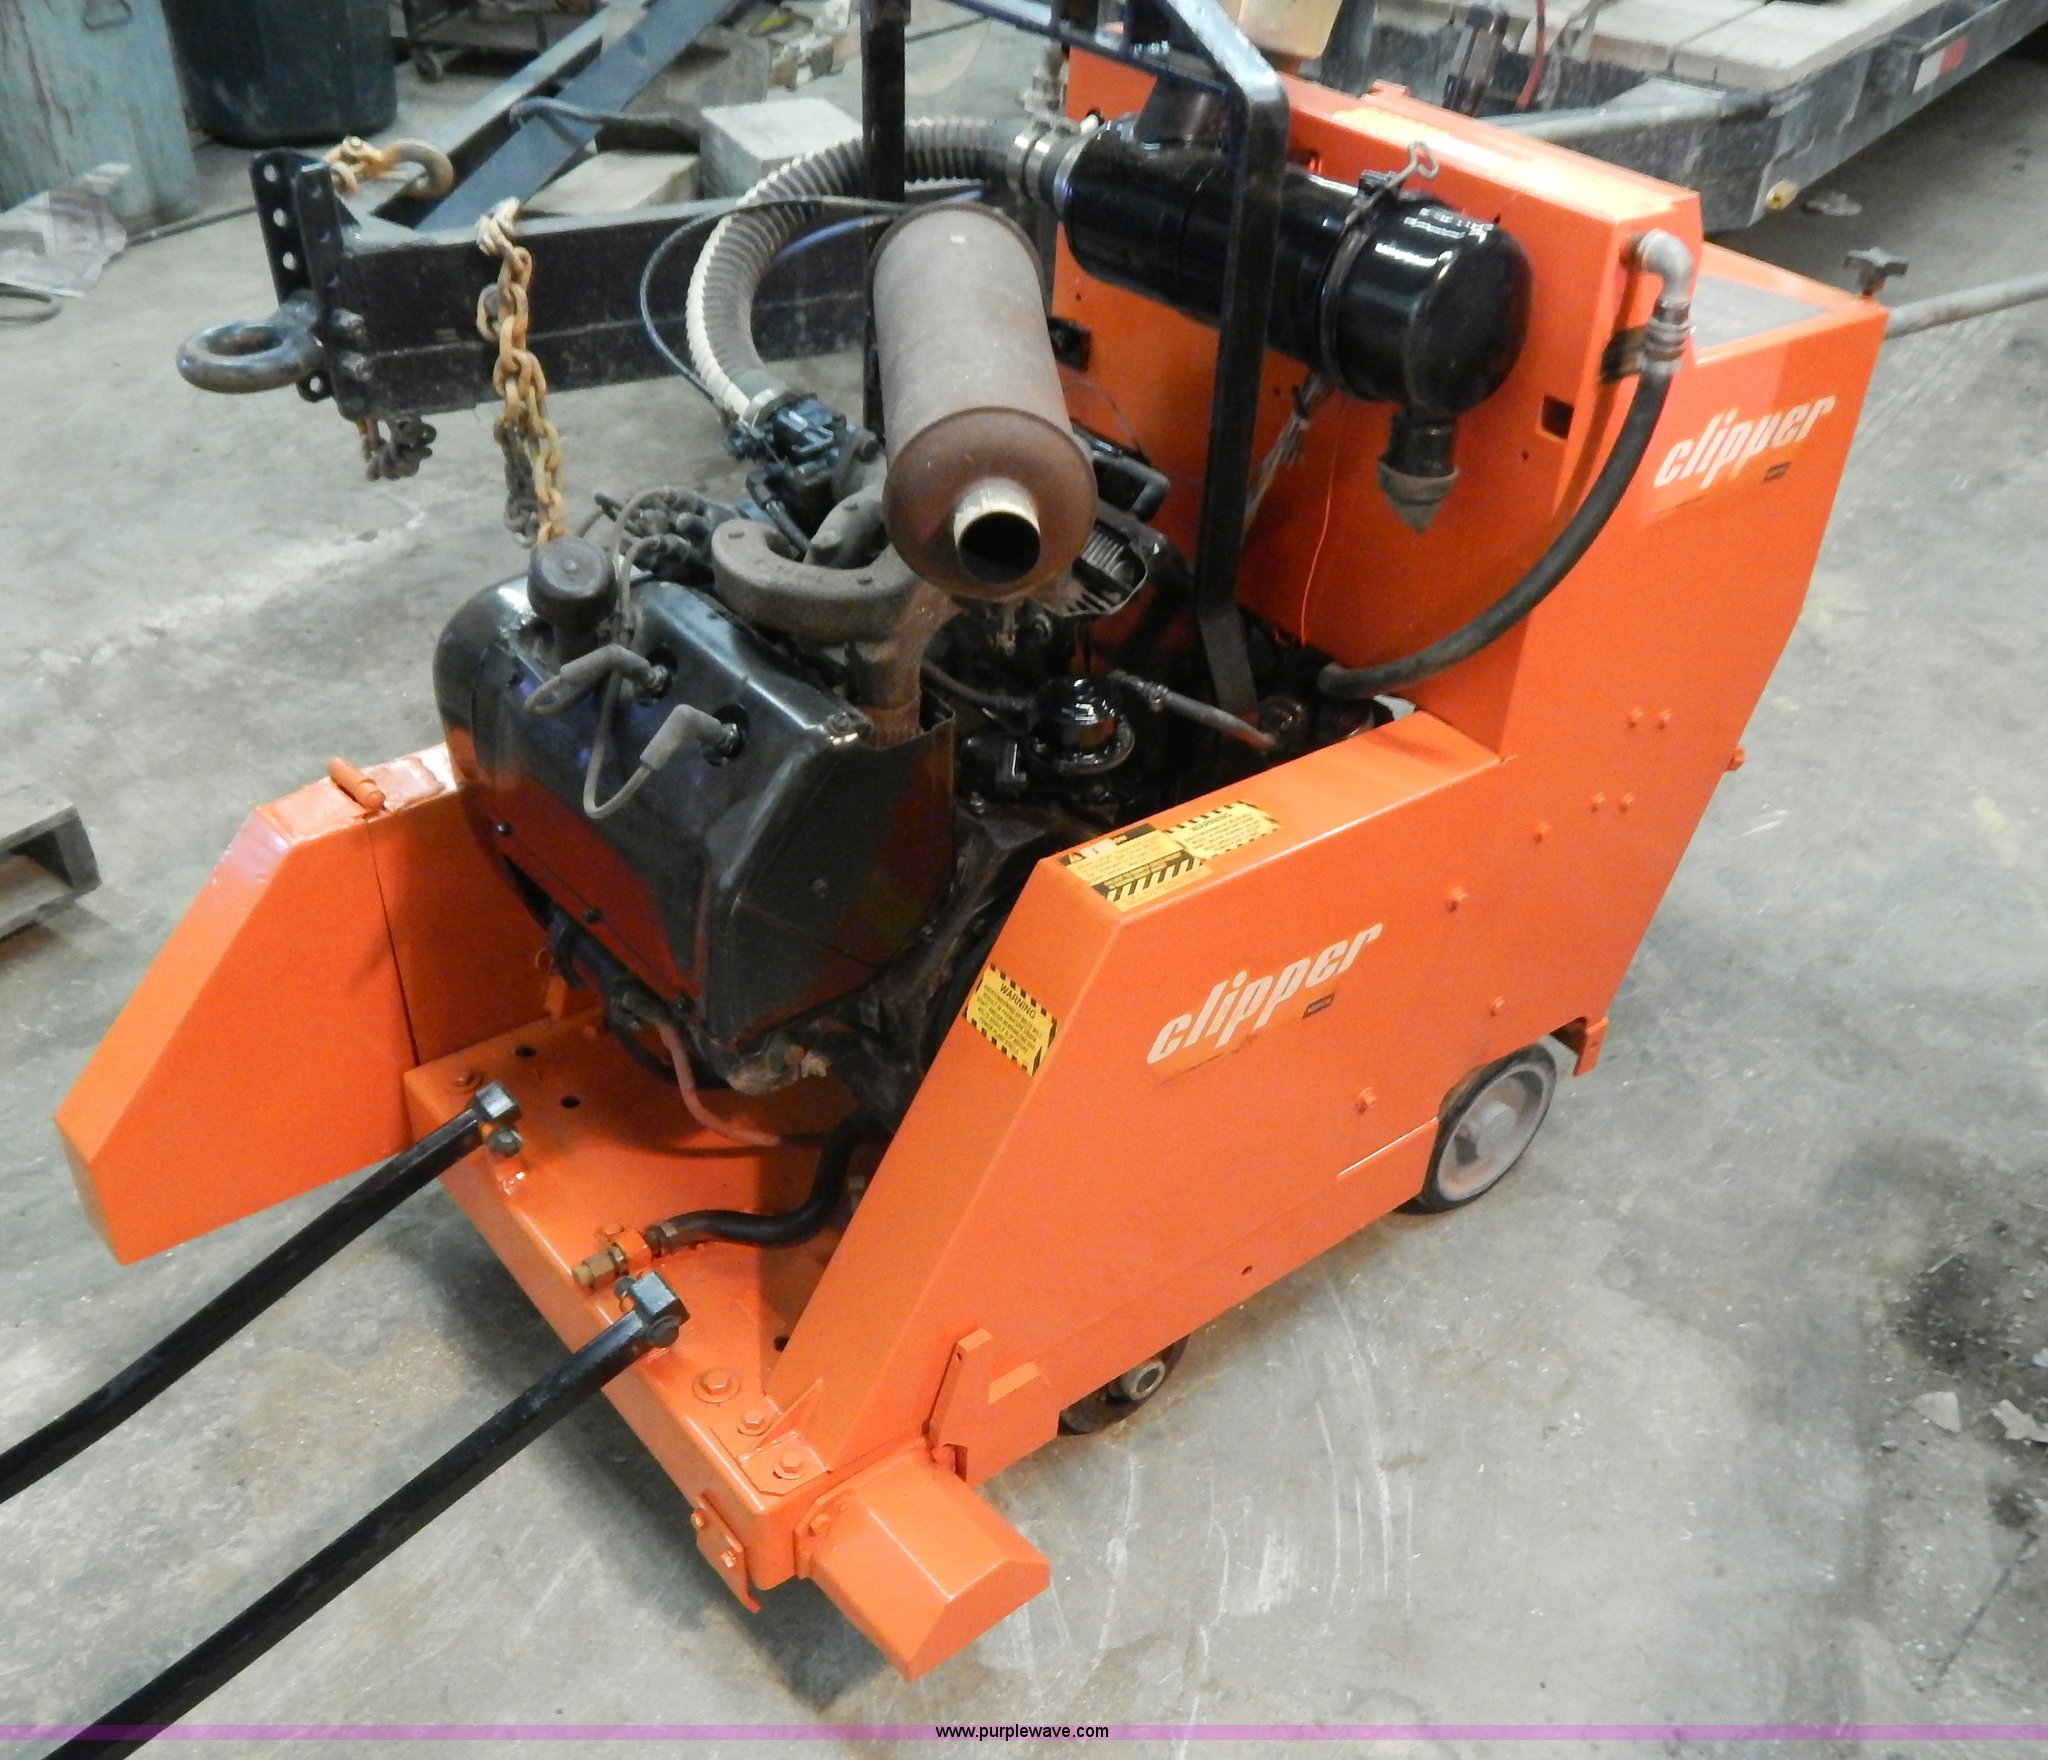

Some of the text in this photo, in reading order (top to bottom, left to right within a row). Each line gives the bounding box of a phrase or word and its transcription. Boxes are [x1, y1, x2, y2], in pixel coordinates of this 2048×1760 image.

[1653, 396, 1836, 490] clipper
[1000, 982, 1037, 1019] WARNING
[1147, 923, 1383, 1064] clipper
